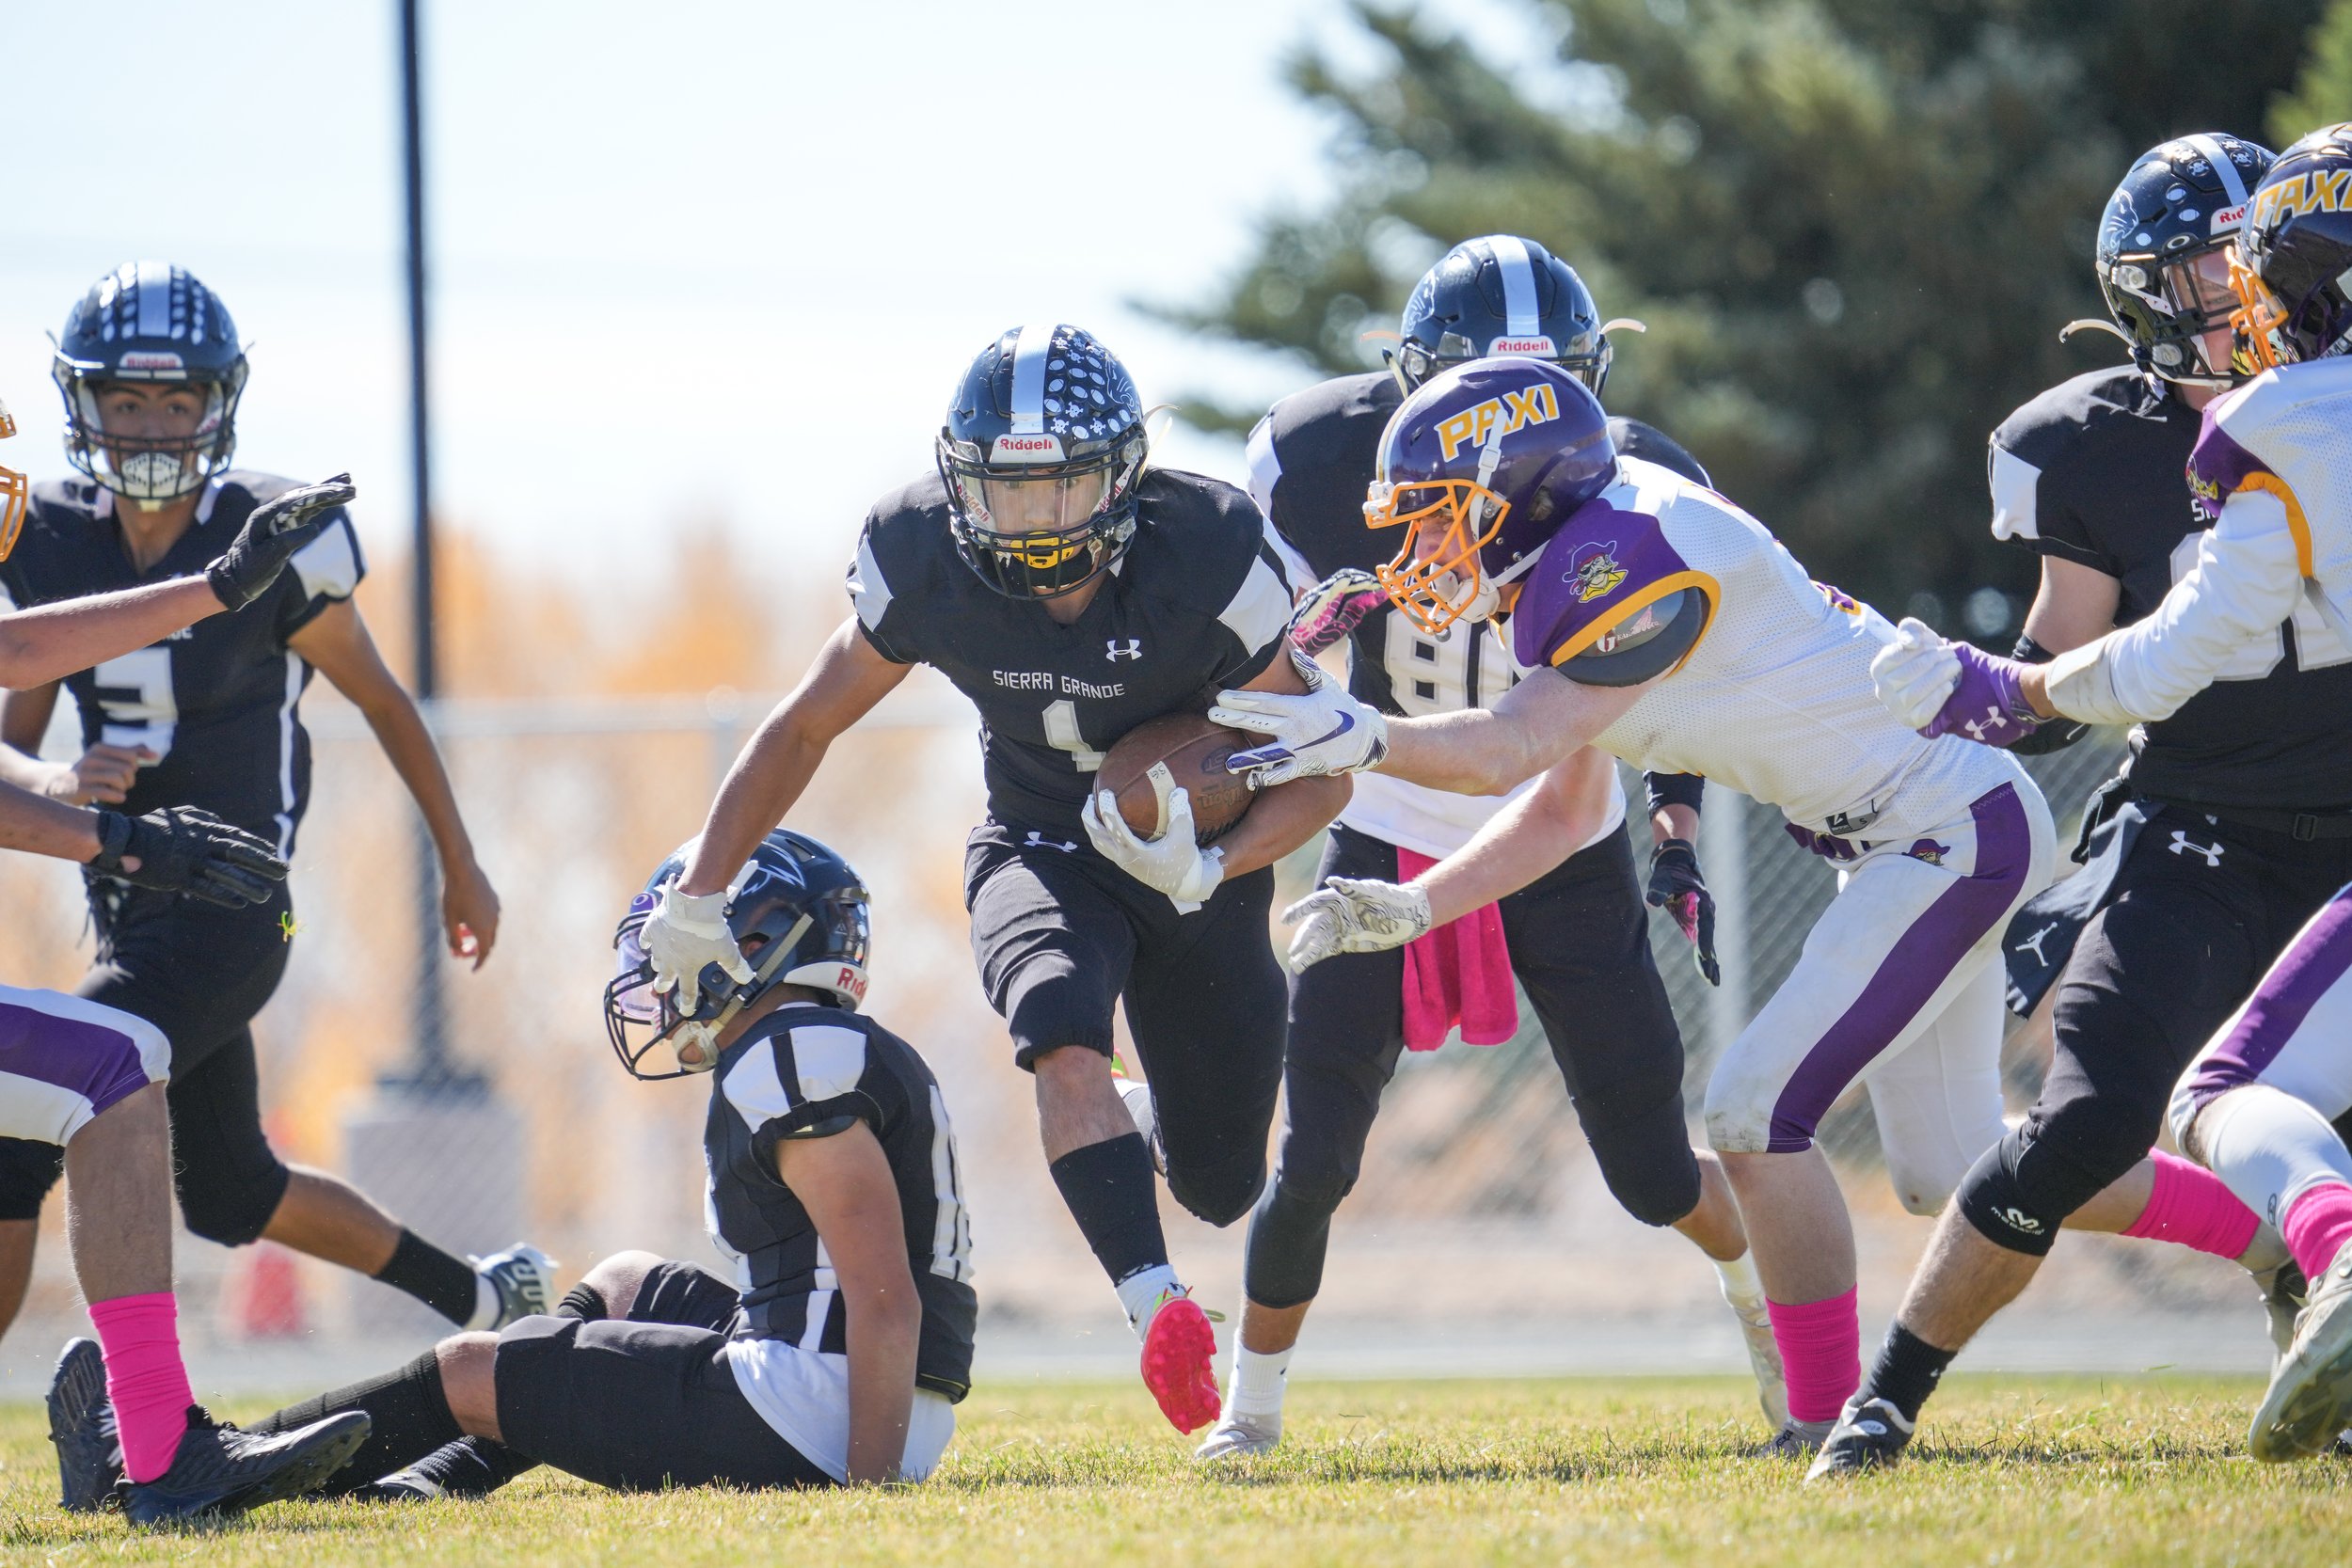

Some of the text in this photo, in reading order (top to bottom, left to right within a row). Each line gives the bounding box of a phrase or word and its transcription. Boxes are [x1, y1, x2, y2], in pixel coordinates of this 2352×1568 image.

[1498, 341, 1549, 352] Riddell
[1434, 383, 1560, 462] PAXI
[1000, 438, 1053, 450] Riddell
[993, 670, 1125, 699] SIERRA GRANDE
[1042, 699, 1106, 772] 1
